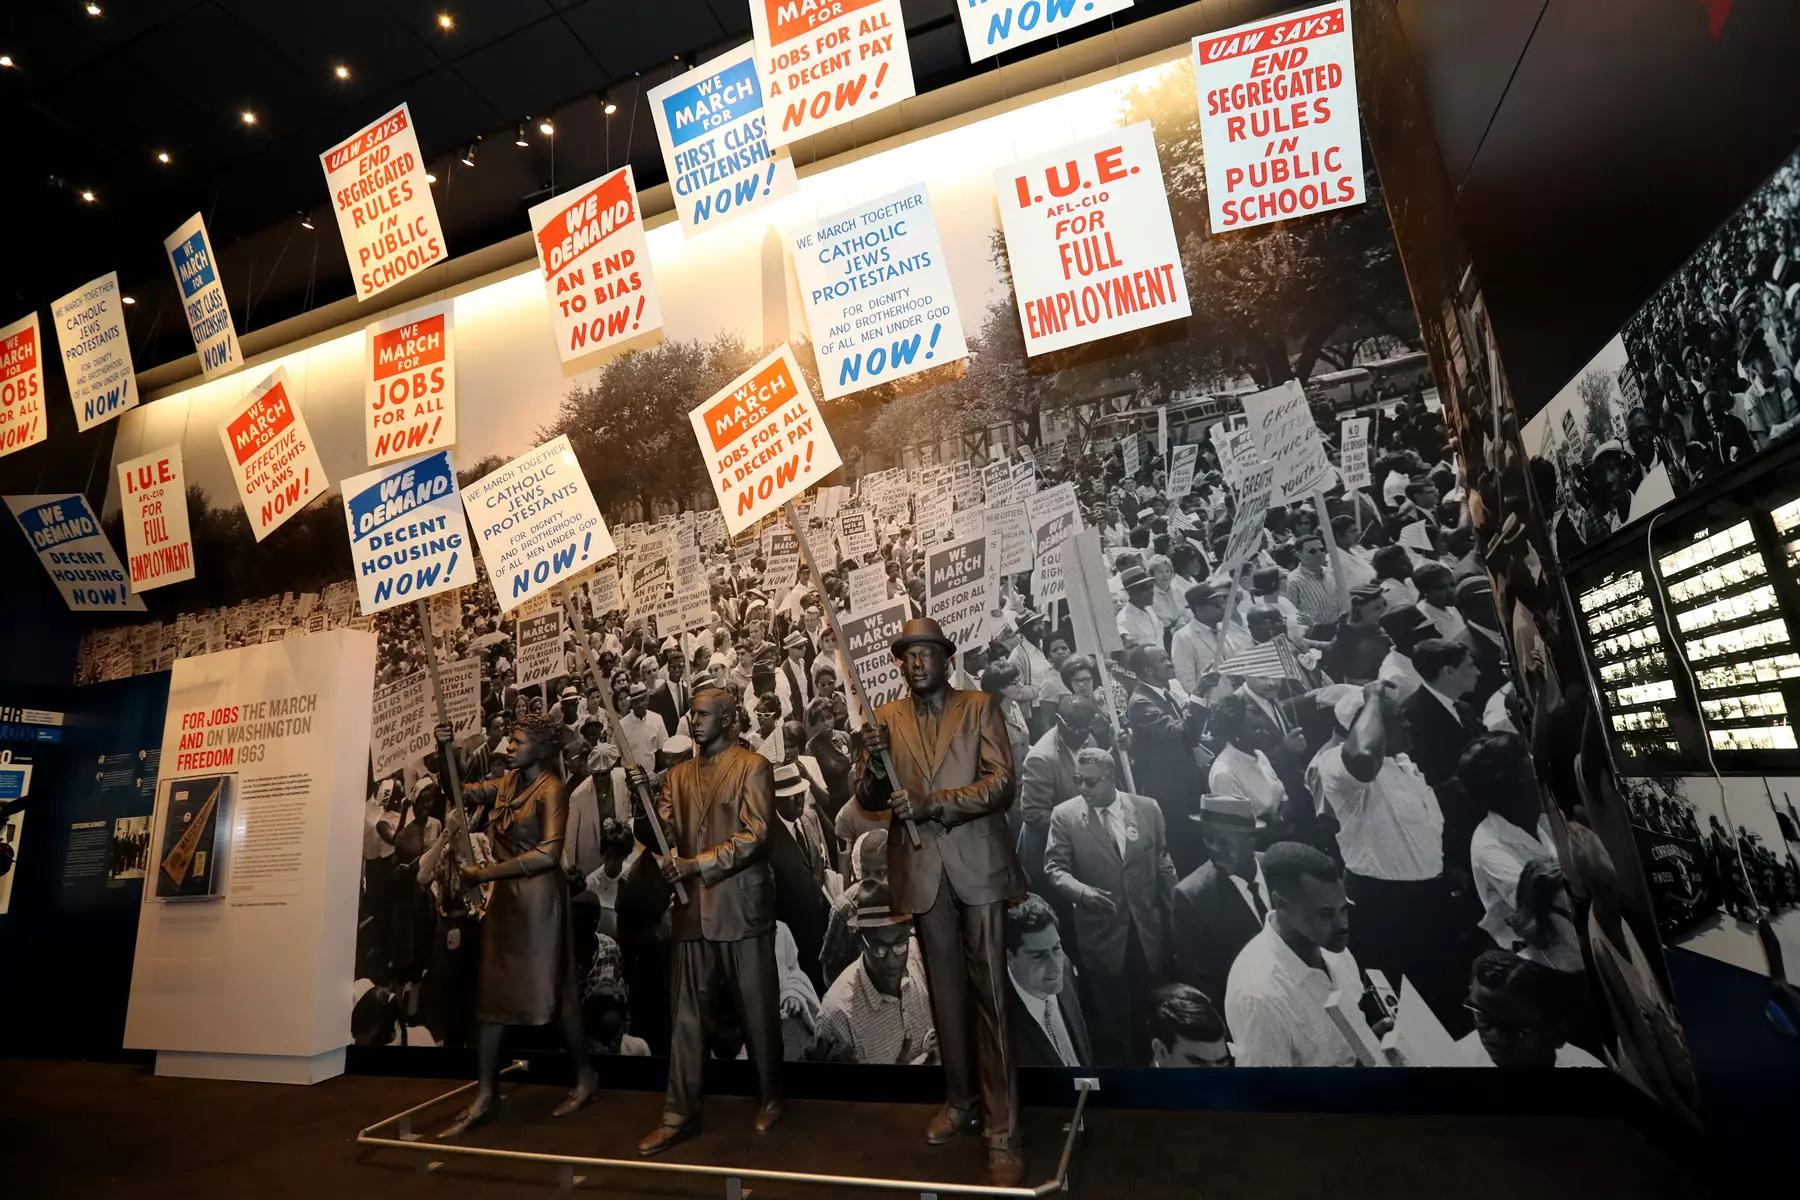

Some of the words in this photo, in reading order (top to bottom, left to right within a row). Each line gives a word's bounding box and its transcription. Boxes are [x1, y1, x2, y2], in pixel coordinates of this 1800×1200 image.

[808, 2, 843, 27] FOR
[769, 44, 810, 75] JOBS
[816, 26, 851, 54] FOR
[859, 11, 891, 36] ALL
[1208, 31, 1265, 60] UAW
[1270, 13, 1342, 46] SAYS:
[770, 80, 782, 98] A
[788, 49, 851, 90] DECENT
[859, 33, 893, 61] PAY
[1250, 46, 1309, 79] END
[675, 77, 754, 129] MARCH
[697, 75, 723, 97] WE
[782, 62, 888, 132] NOW!
[1207, 62, 1343, 117] SEGREGATED
[702, 109, 732, 131] FOR
[1227, 97, 1331, 143] RULES
[331, 138, 362, 169] UAW
[359, 144, 391, 176] END
[674, 139, 716, 175] FIRST
[1264, 135, 1299, 157] IN
[336, 152, 415, 211] SEGREGATED
[1015, 145, 1140, 208] I.U.E.
[1226, 146, 1343, 193] PUBLIC
[352, 180, 413, 228] RULES
[694, 162, 776, 225] NOW!
[1046, 191, 1109, 218] AFL-CIO
[1222, 176, 1355, 226] SCHOOLS
[379, 213, 398, 235] IN
[565, 194, 598, 235] WE
[796, 234, 813, 250] WE
[817, 218, 857, 242] MARCH
[860, 194, 922, 226] TOGETHER
[1055, 210, 1105, 240] FOR
[358, 216, 428, 268] PUBLIC
[550, 199, 630, 271] DEMAND
[819, 221, 907, 264] CATHOLIC
[179, 249, 209, 282] MARCH
[361, 237, 440, 294] SCHOOLS
[557, 269, 585, 296] AN
[592, 249, 635, 280] END
[844, 246, 890, 275] JEWS
[1058, 231, 1123, 281] FULL
[559, 295, 586, 318] TO
[594, 272, 642, 305] BIAS
[812, 252, 931, 305] PROTESTANTS
[66, 301, 107, 330] CATHOLIC
[203, 287, 223, 315] CLASS
[829, 322, 851, 338] AND
[855, 295, 932, 329] BROTHERHOOD
[842, 303, 863, 318] FOR
[868, 287, 910, 309] DIGNITY
[1025, 263, 1177, 339] EMPLOYMENT
[80, 320, 100, 340] JEWS
[192, 308, 229, 345] CITIZENSHIP
[400, 324, 418, 340] WE
[571, 294, 645, 351] NOW!
[838, 337, 856, 351] ALL
[861, 328, 883, 342] MEN
[886, 314, 922, 334] UNDER
[927, 305, 950, 322] GOD
[66, 325, 120, 361] PROTESTANTS
[204, 334, 232, 372] NOW!
[379, 331, 439, 366] MARCH
[839, 322, 941, 386] NOW!
[397, 356, 420, 372] FOR
[84, 379, 128, 422] NOW!
[372, 366, 445, 410] JOBS
[715, 374, 786, 435] MARCH
[733, 380, 757, 402] WE
[236, 398, 287, 450] MARCH
[247, 401, 265, 420] WE
[373, 408, 405, 428] FOR
[414, 398, 444, 417] ALL
[740, 405, 769, 430] FOR
[245, 428, 296, 480] EFFECTIVE
[255, 428, 275, 448] FOR
[375, 415, 442, 458] NOW!
[717, 443, 749, 474] JOBS
[751, 422, 780, 449] FOR
[783, 403, 808, 427] ALL
[734, 440, 784, 482] DECENT
[786, 417, 814, 445] PAY
[126, 459, 176, 494] I.U.E.
[246, 471, 270, 495] CIVIL
[271, 440, 306, 475] RIGHTS
[265, 466, 294, 494] LAWS
[380, 469, 415, 502] WE
[483, 471, 516, 493] MARCH
[517, 443, 566, 474] TOGETHER
[737, 440, 814, 516] NOW!
[261, 467, 309, 527] NOW!
[360, 475, 448, 533] DEMAND
[486, 464, 556, 508] CATHOLIC
[508, 485, 544, 512] JEWS
[38, 505, 65, 525] WE
[142, 501, 162, 519] FOR
[483, 482, 578, 541] PROTESTANTS
[34, 517, 93, 547] DEMAND
[143, 516, 169, 546] FULL
[369, 515, 446, 551] DECENT
[500, 548, 518, 563] AND
[521, 513, 582, 551] BROTHERHOOD
[510, 531, 527, 546] FOR
[530, 511, 564, 534] DIGNITY
[547, 529, 576, 549] UNDER
[579, 517, 598, 532] GOD
[48, 551, 106, 564] DECENT
[130, 542, 190, 582] EMPLOYMENT
[361, 533, 462, 576] HOUSING
[513, 531, 592, 599] NOW!
[934, 554, 982, 585] MARCH
[949, 547, 967, 562] WE
[52, 569, 125, 582] HOUSING
[374, 551, 458, 604] NOW!
[948, 575, 968, 588] FOR
[73, 584, 127, 605] NOW!
[930, 599, 950, 616] JOBS
[952, 591, 969, 606] FOR
[971, 585, 985, 599] ALL
[969, 600, 985, 615] PAY
[522, 622, 557, 640] MARCH
[850, 620, 903, 650] MARCH
[864, 614, 883, 629] WE
[523, 640, 558, 656] EFFECTIVE
[530, 657, 549, 668] LAWS
[867, 640, 888, 652] FOR
[522, 660, 558, 683] NOW!
[182, 711, 205, 731] FOR
[207, 706, 239, 727] JOBS
[242, 701, 266, 721] THE
[269, 693, 317, 718] MARCH
[178, 731, 204, 751] AND
[207, 728, 224, 747] ON
[227, 715, 312, 744] WASHINGTON
[176, 747, 234, 771] FREEDOM
[237, 743, 266, 765] 1963
